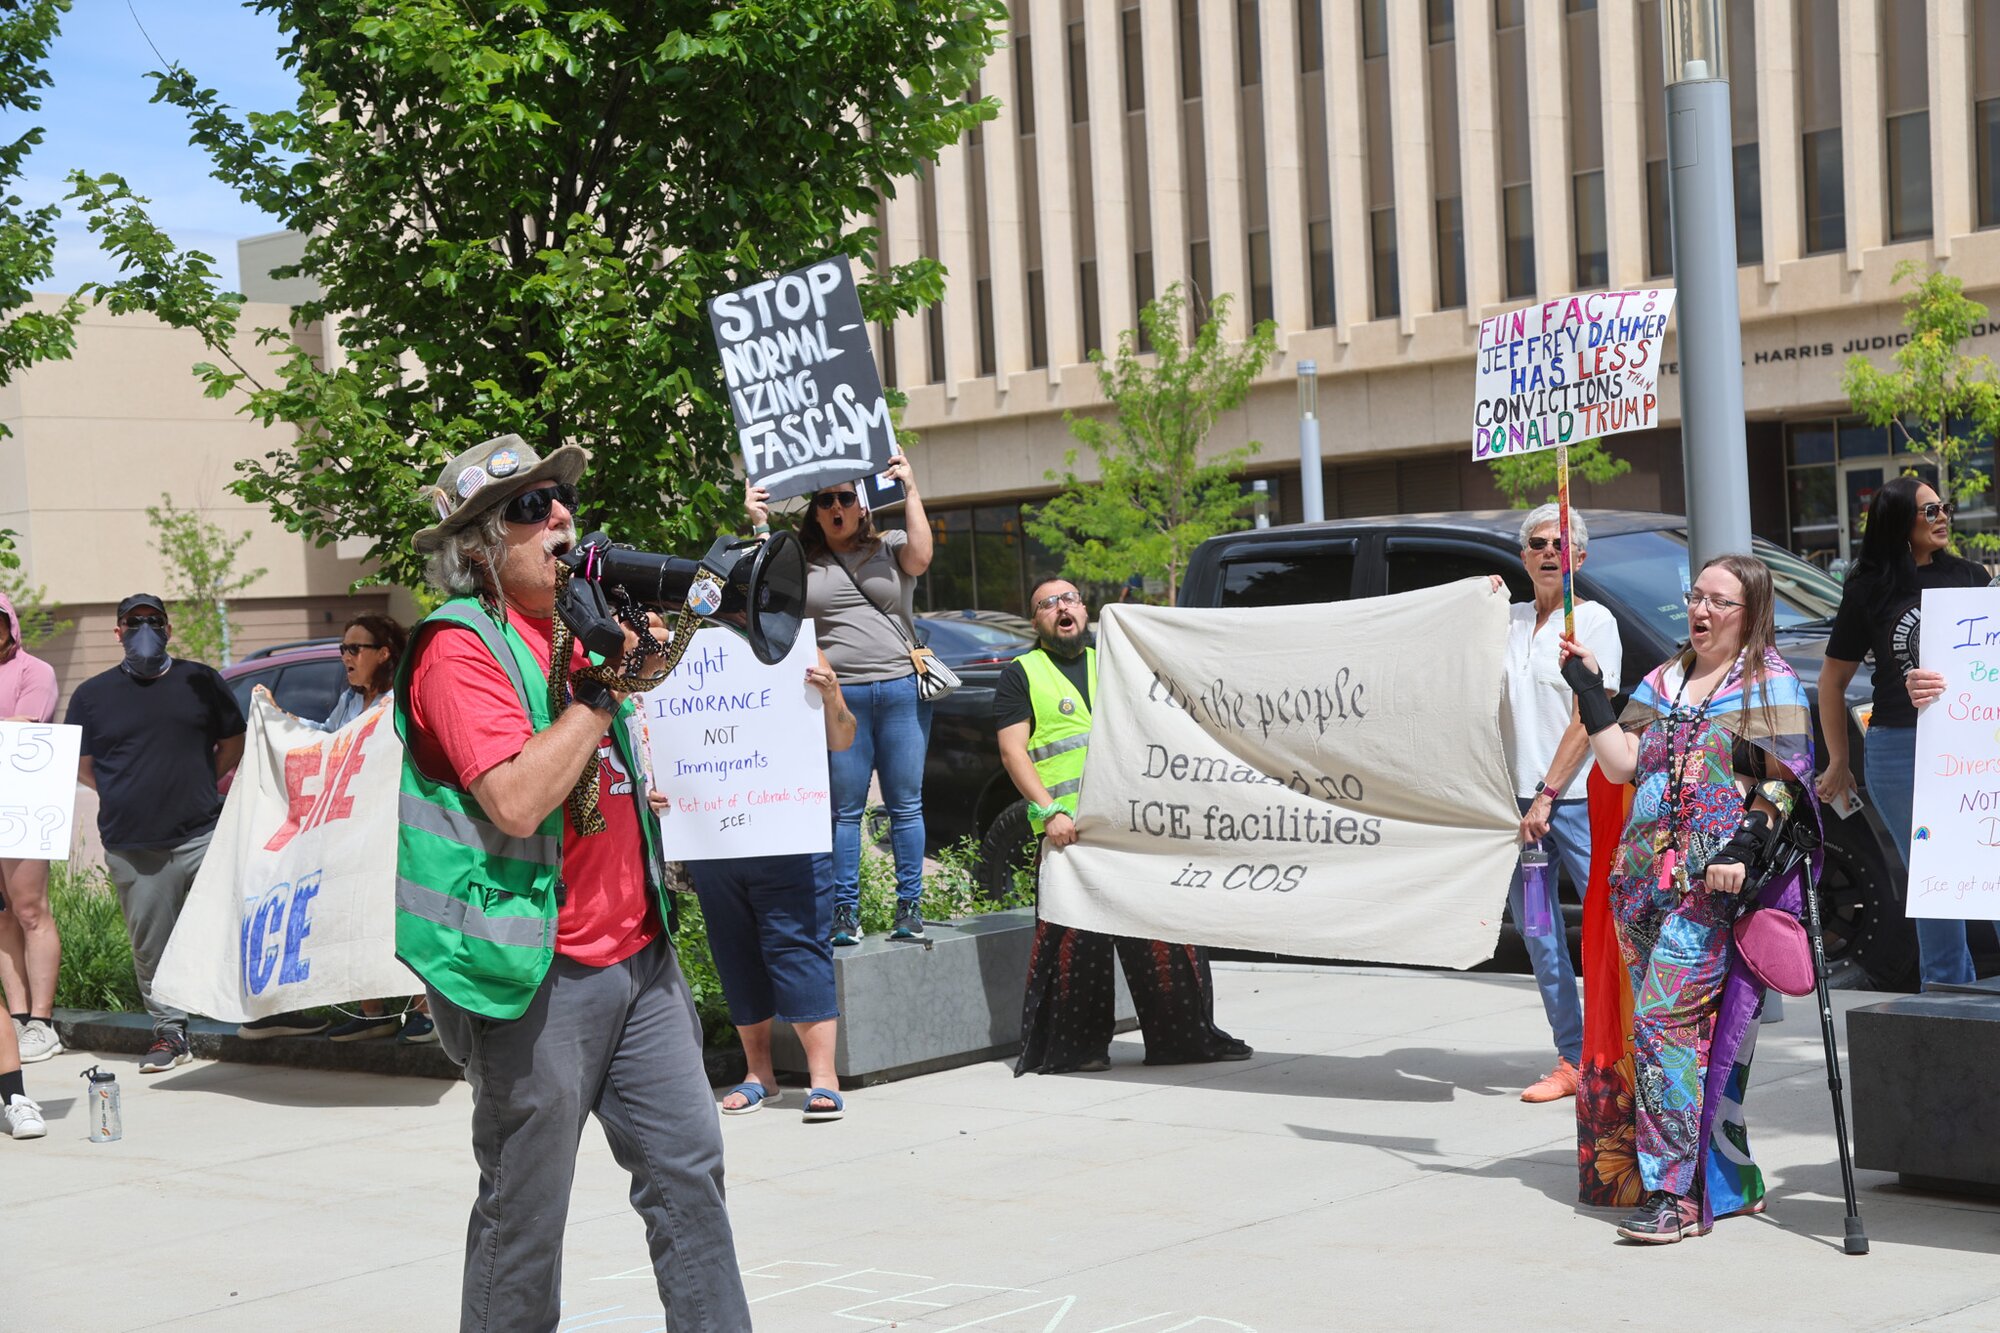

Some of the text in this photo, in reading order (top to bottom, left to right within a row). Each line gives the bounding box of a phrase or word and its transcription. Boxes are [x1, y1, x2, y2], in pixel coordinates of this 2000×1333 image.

[713, 262, 842, 342] STOP
[1480, 308, 1526, 351] FUN
[1482, 314, 1667, 375] JEFFREY DAHMER
[1510, 339, 1652, 396] HAS LESS
[1755, 342, 1834, 364] HARRIS
[733, 369, 819, 425] IZING
[1475, 369, 1655, 427] CONVICTIONS THAN
[739, 384, 900, 475] FASCISM
[1476, 393, 1657, 457] DONALD TRUMP
[655, 688, 772, 719] IGNORANCE
[1200, 678, 1250, 734] the
[1254, 666, 1370, 744] people
[703, 725, 740, 746] NOT
[673, 750, 769, 782] Immigrants
[1315, 773, 1364, 801] no
[678, 796, 698, 813] Get
[704, 796, 723, 812] out
[728, 793, 739, 808] of
[747, 788, 791, 806] Colorado
[719, 813, 752, 832] ICE!
[1128, 800, 1382, 846] ICE facilities
[1170, 862, 1308, 893] in COS
[1919, 875, 1949, 897] Ice
[1957, 875, 1977, 900] get
